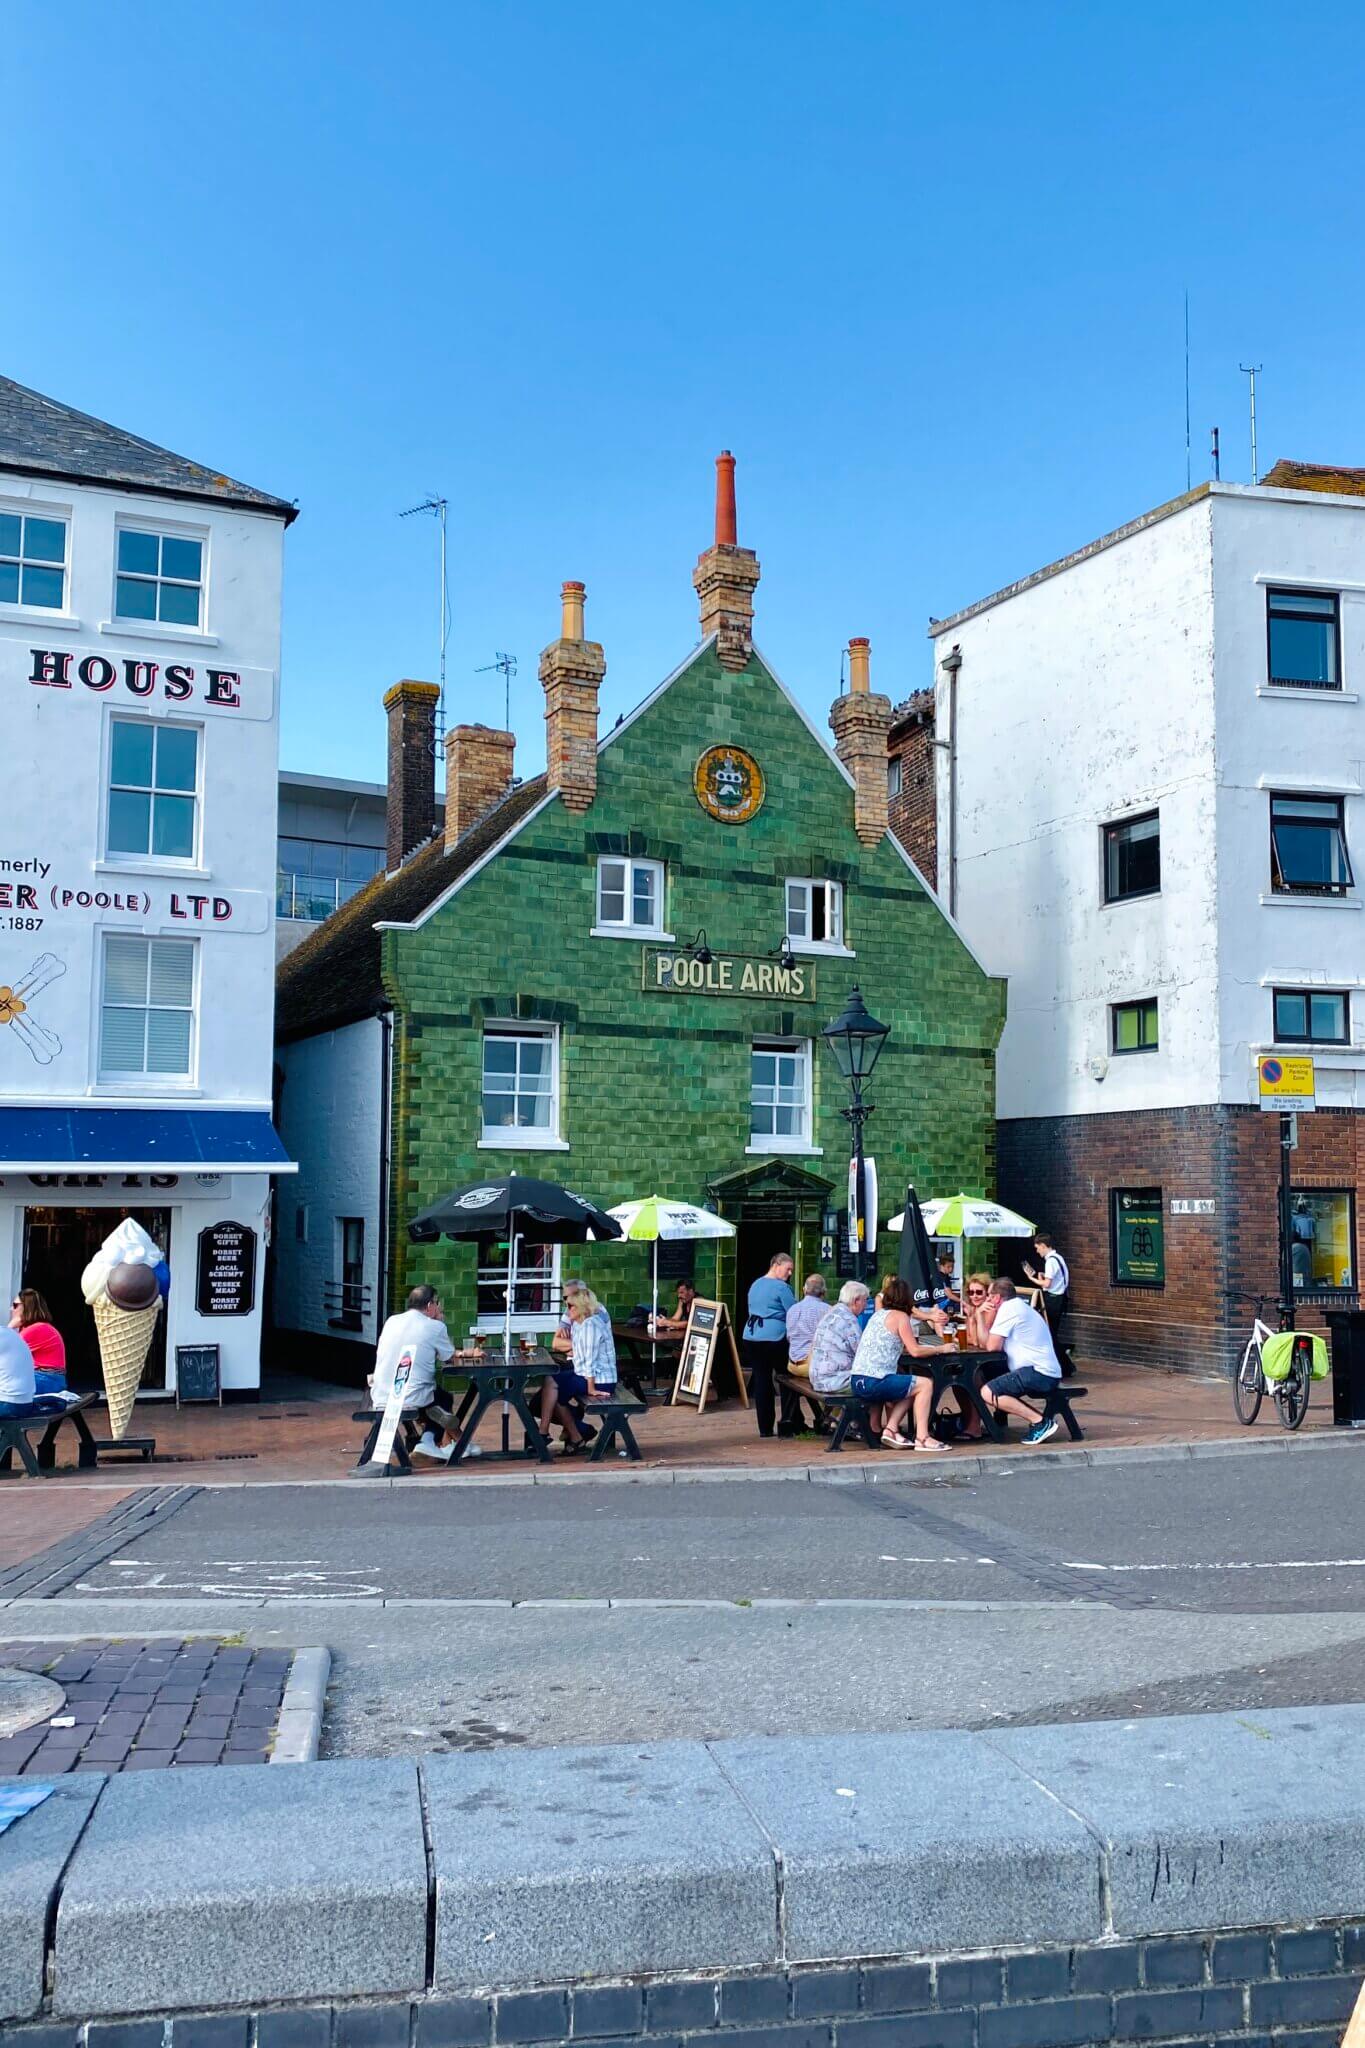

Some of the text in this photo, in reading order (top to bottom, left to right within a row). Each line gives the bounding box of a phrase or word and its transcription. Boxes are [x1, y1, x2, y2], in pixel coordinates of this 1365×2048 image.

[29, 649, 241, 708] HOUSE
[50, 885, 152, 914] (POOLE)
[170, 894, 233, 921] LTD
[656, 956, 805, 996] POOLE ARMS
